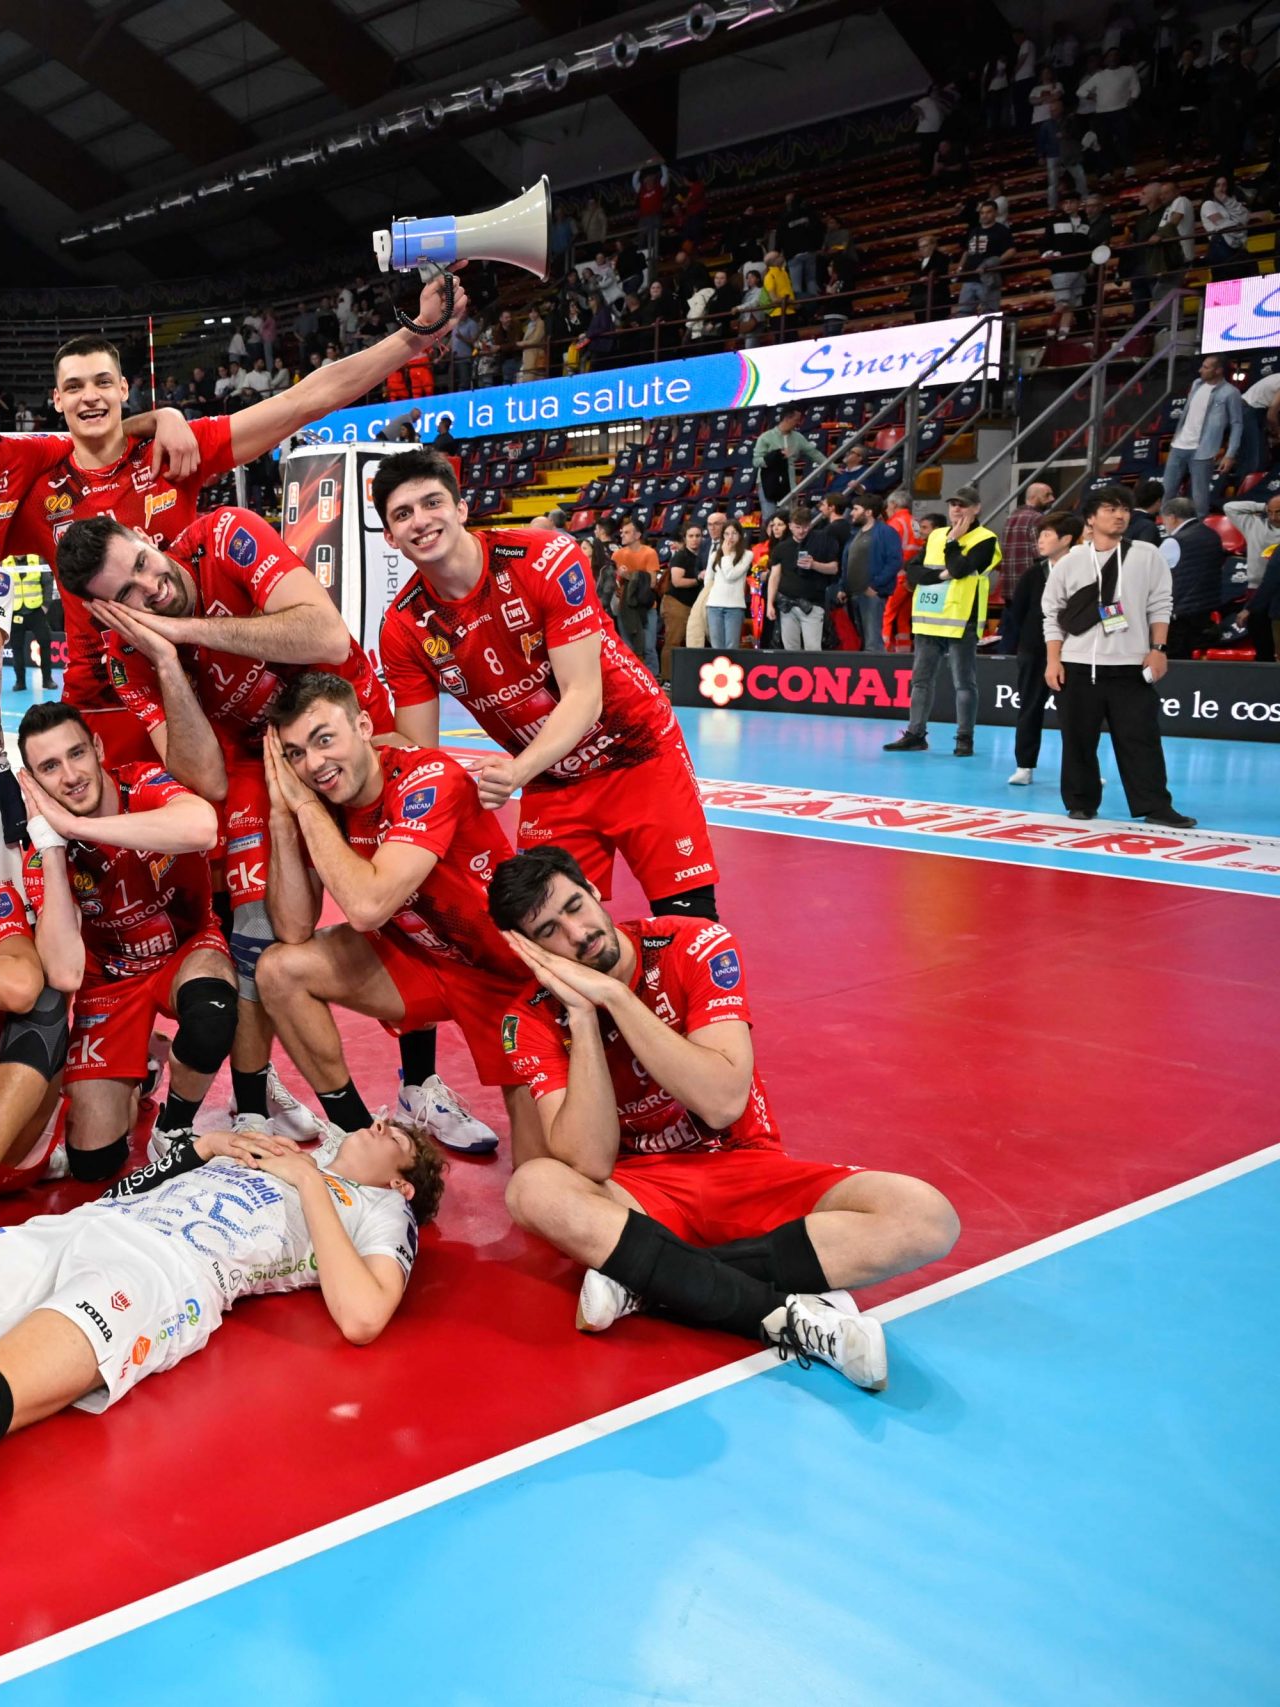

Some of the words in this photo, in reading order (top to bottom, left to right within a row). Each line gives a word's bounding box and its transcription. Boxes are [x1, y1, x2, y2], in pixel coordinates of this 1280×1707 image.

[342, 422, 358, 444] a
[467, 401, 494, 428] la
[506, 396, 559, 421] tua
[572, 377, 691, 415] salute
[1134, 439, 1150, 447] E37
[92, 482, 120, 493] COMTEL
[495, 547, 524, 557] Hotpoint
[531, 535, 571, 572] beko
[383, 552, 401, 603] uard
[496, 572, 511, 585] LUBE
[397, 585, 422, 610] Hotpoint
[919, 592, 939, 604] 059
[467, 613, 493, 631] COMTEL
[507, 607, 523, 619] TWS
[483, 647, 504, 676] 8
[468, 660, 552, 713] VARGROUP
[1192, 690, 1219, 720] le
[405, 801, 431, 812] UNICAM
[824, 794, 1026, 820] FRATELLI
[349, 835, 376, 844] COMTEL
[675, 837, 693, 850] LUBE
[715, 966, 738, 978] UNICAM
[530, 989, 550, 1005] Hotpo
[225, 1178, 264, 1210] MARCHI
[246, 1172, 284, 1205] Baldi
[112, 1290, 132, 1309] LUBE
